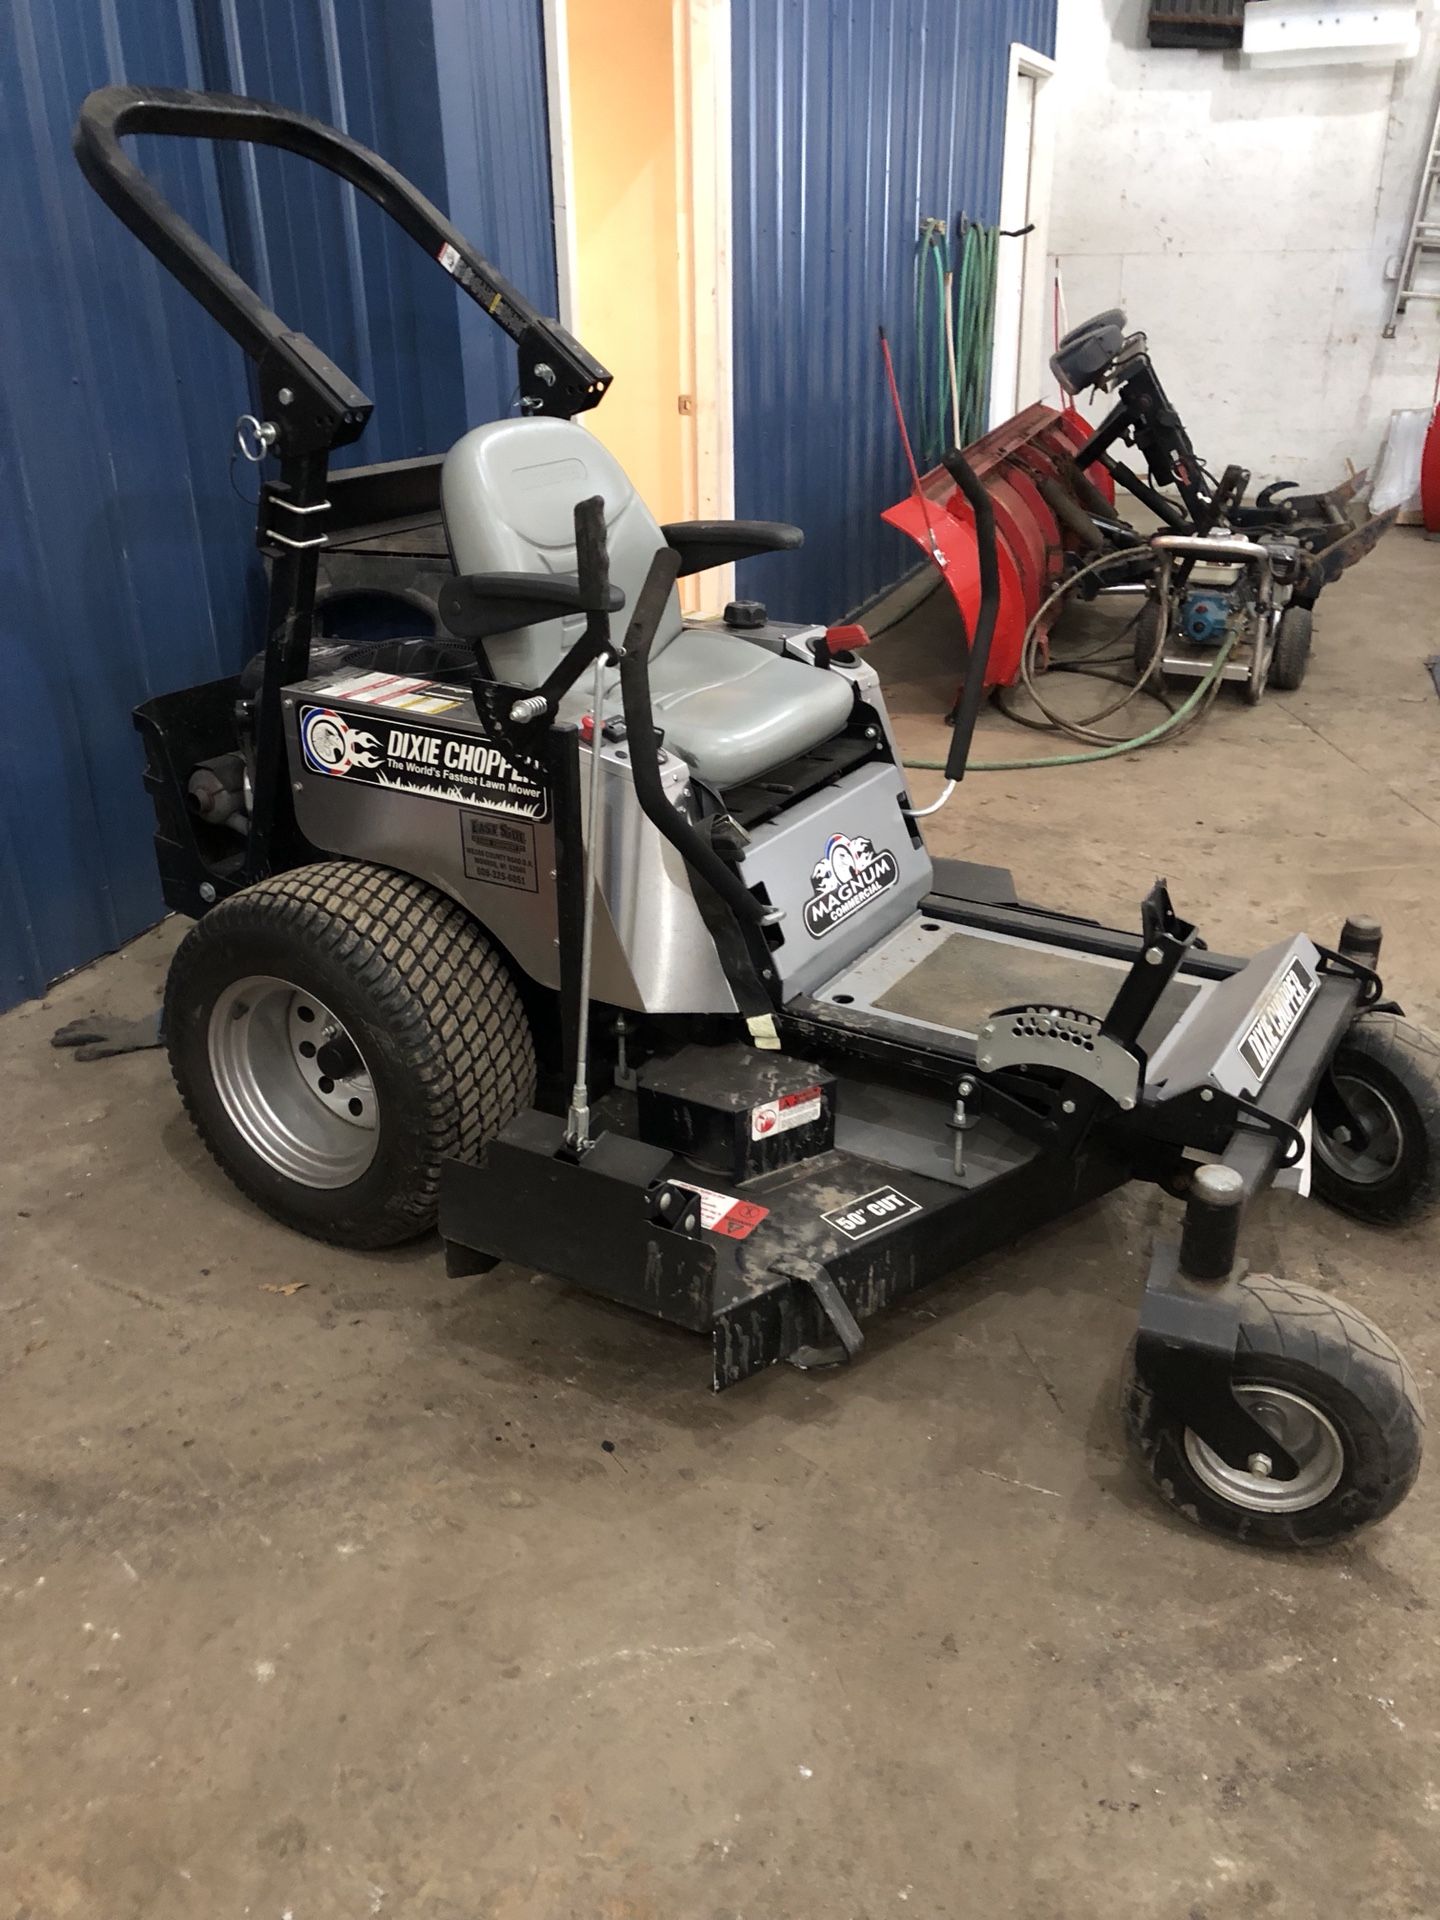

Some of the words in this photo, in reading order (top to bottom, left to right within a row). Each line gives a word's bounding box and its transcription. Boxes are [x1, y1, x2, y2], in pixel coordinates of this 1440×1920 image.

[387, 730, 441, 765] DIXIE
[387, 757, 404, 770] The
[406, 761, 441, 778] World's
[443, 769, 478, 786] Fastest
[480, 777, 505, 791] Lawn
[507, 782, 541, 798] Mower
[811, 858, 891, 922] MAGNUM
[830, 881, 882, 921] COMMERCIAL
[1247, 1012, 1281, 1069] DIXIE
[1269, 969, 1308, 1037] CHOPPER
[835, 1208, 867, 1230] 50"
[866, 1194, 905, 1216] CUT
